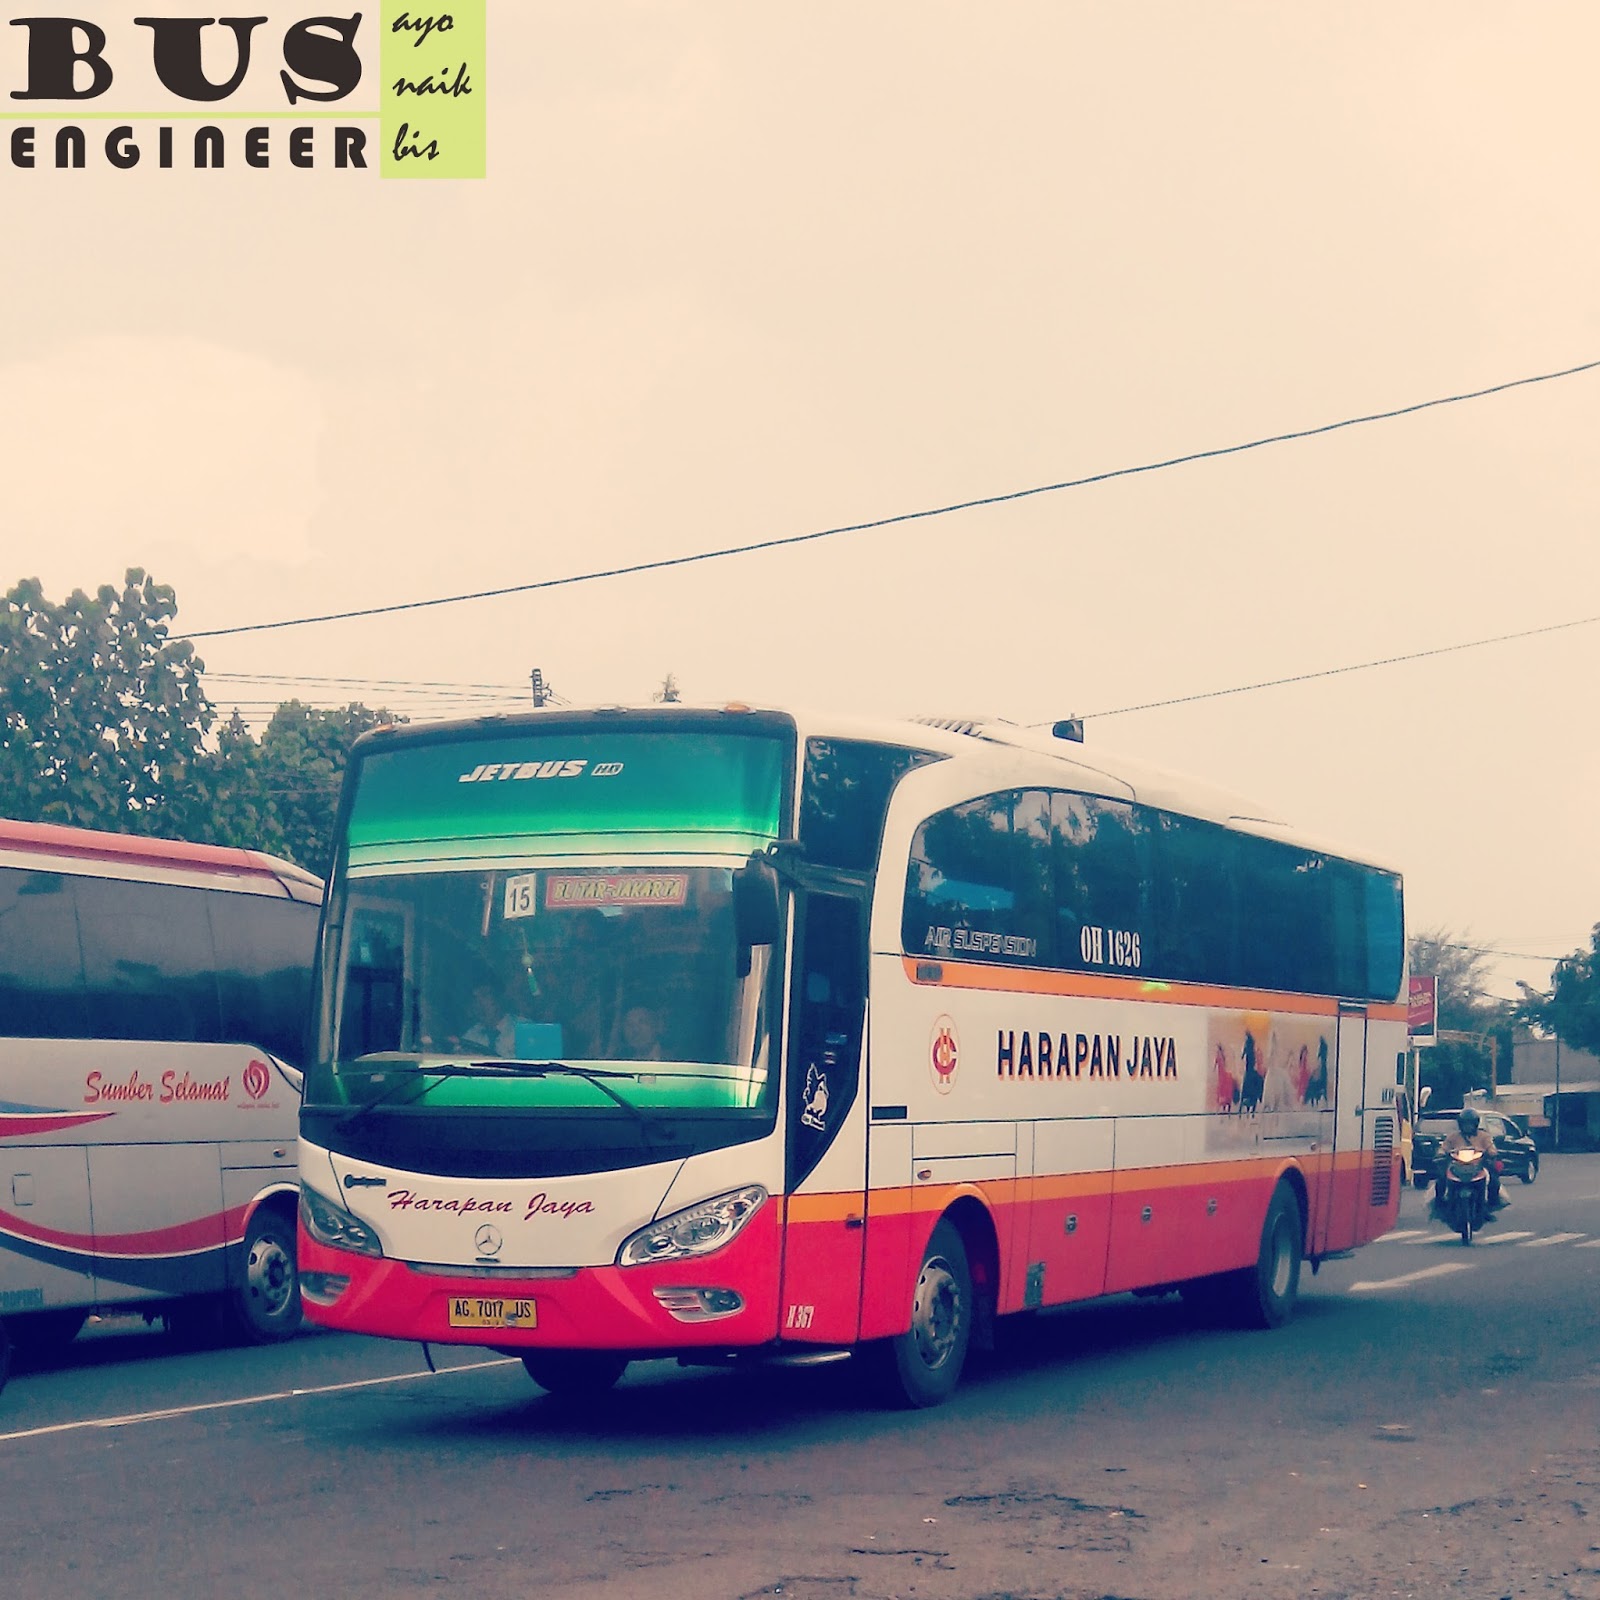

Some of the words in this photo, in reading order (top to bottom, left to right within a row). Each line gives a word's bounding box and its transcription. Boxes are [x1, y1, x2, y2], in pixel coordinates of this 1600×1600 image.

[460, 760, 587, 782] JETBUS
[510, 885, 530, 912] 15
[925, 926, 951, 948] AIR
[954, 929, 1036, 957] SUSPENSION
[1080, 926, 1103, 963] OH
[1108, 929, 1141, 968] 1626
[998, 1030, 1121, 1080] HARAPAN
[1126, 1036, 1178, 1080] JAYA
[84, 1070, 154, 1103] Sumber
[160, 1070, 230, 1103] Selamat
[387, 1190, 512, 1216] Harapan
[524, 1193, 595, 1220] Jaya
[455, 1300, 469, 1316] AG
[477, 1301, 503, 1317] 7017
[515, 1302, 530, 1318] US
